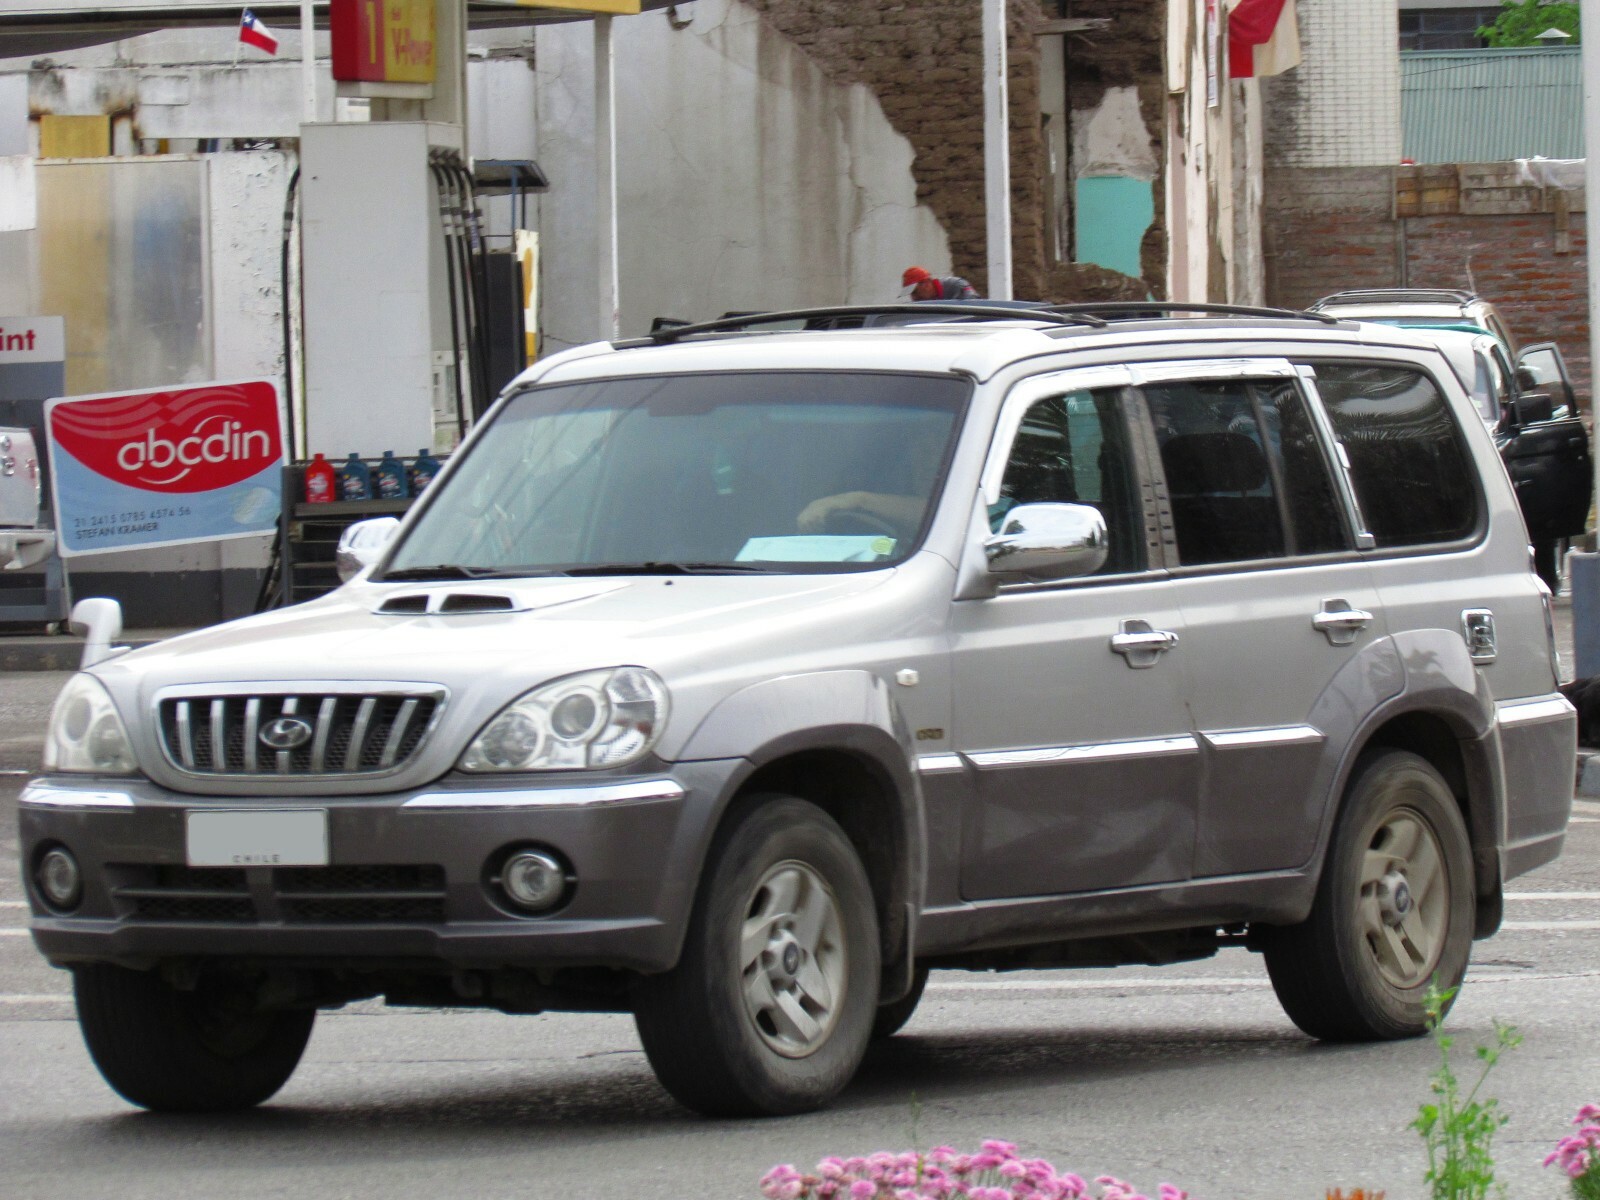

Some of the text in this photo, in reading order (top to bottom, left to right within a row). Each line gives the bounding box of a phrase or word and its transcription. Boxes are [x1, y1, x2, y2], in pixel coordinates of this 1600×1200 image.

[117, 420, 270, 471] abcdin
[118, 522, 158, 535] KRAMER
[232, 854, 281, 863] CHILE
